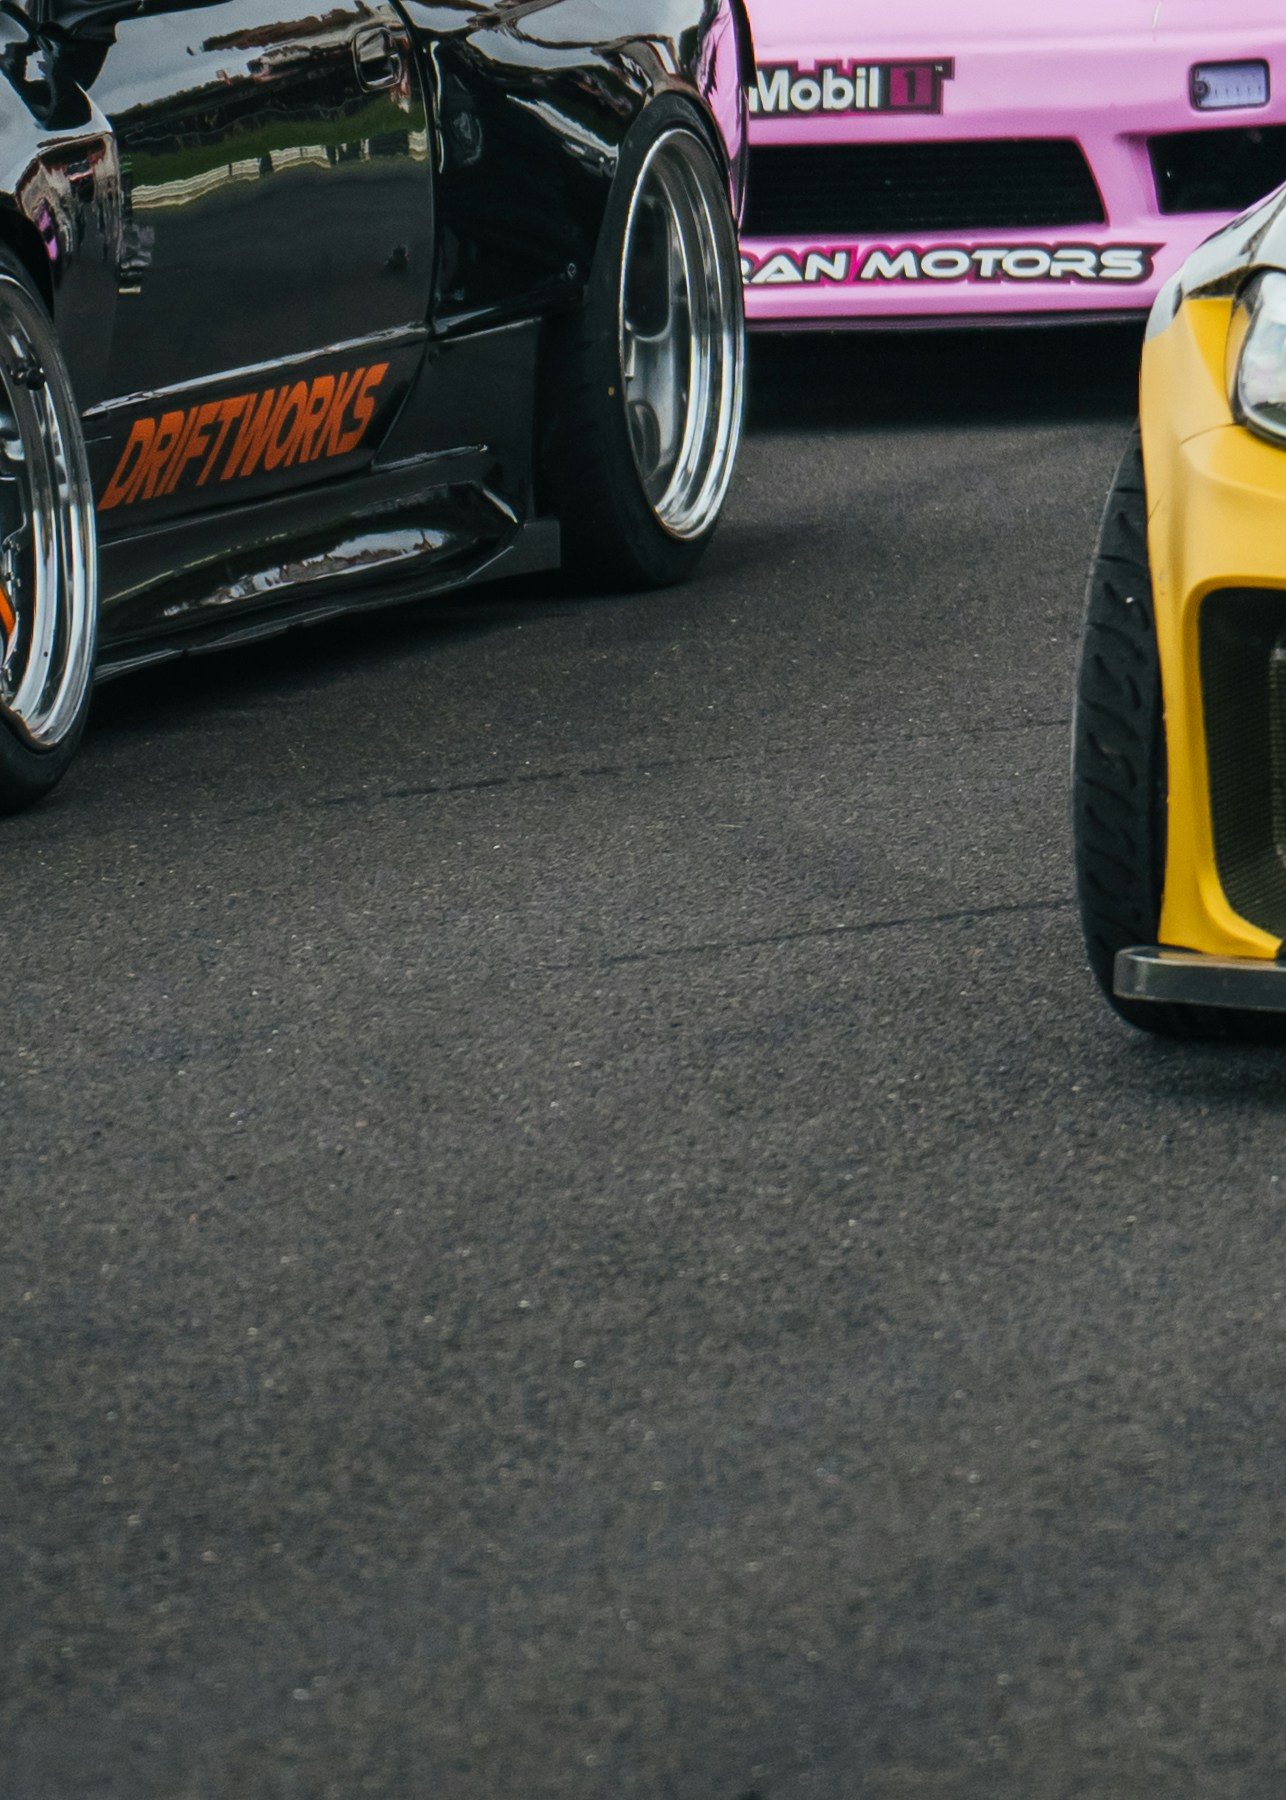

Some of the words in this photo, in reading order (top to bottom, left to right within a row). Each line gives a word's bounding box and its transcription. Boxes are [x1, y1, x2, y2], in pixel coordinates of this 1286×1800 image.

[749, 66, 880, 112] Mobil
[860, 249, 1144, 280] MOTORS
[97, 362, 390, 512] DRIFTWORKS
